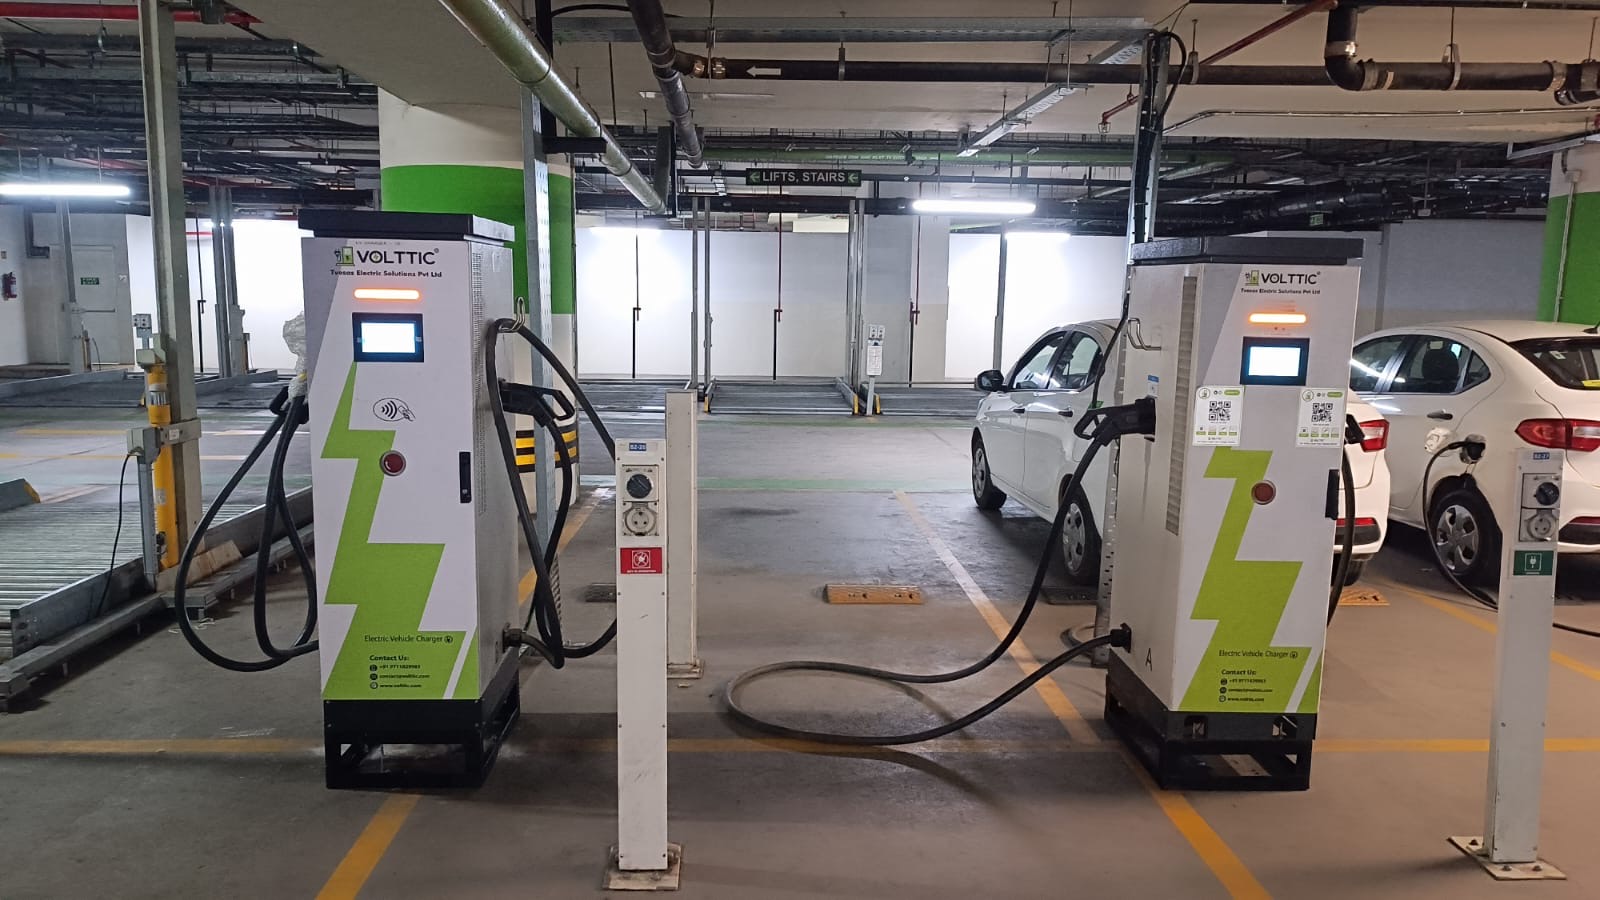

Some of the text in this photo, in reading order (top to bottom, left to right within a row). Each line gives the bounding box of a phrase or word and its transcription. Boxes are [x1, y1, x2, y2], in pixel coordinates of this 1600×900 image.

[762, 171, 845, 183] LIFTS, STAIRS
[415, 635, 443, 643] Charger
[1145, 647, 1153, 672] A
